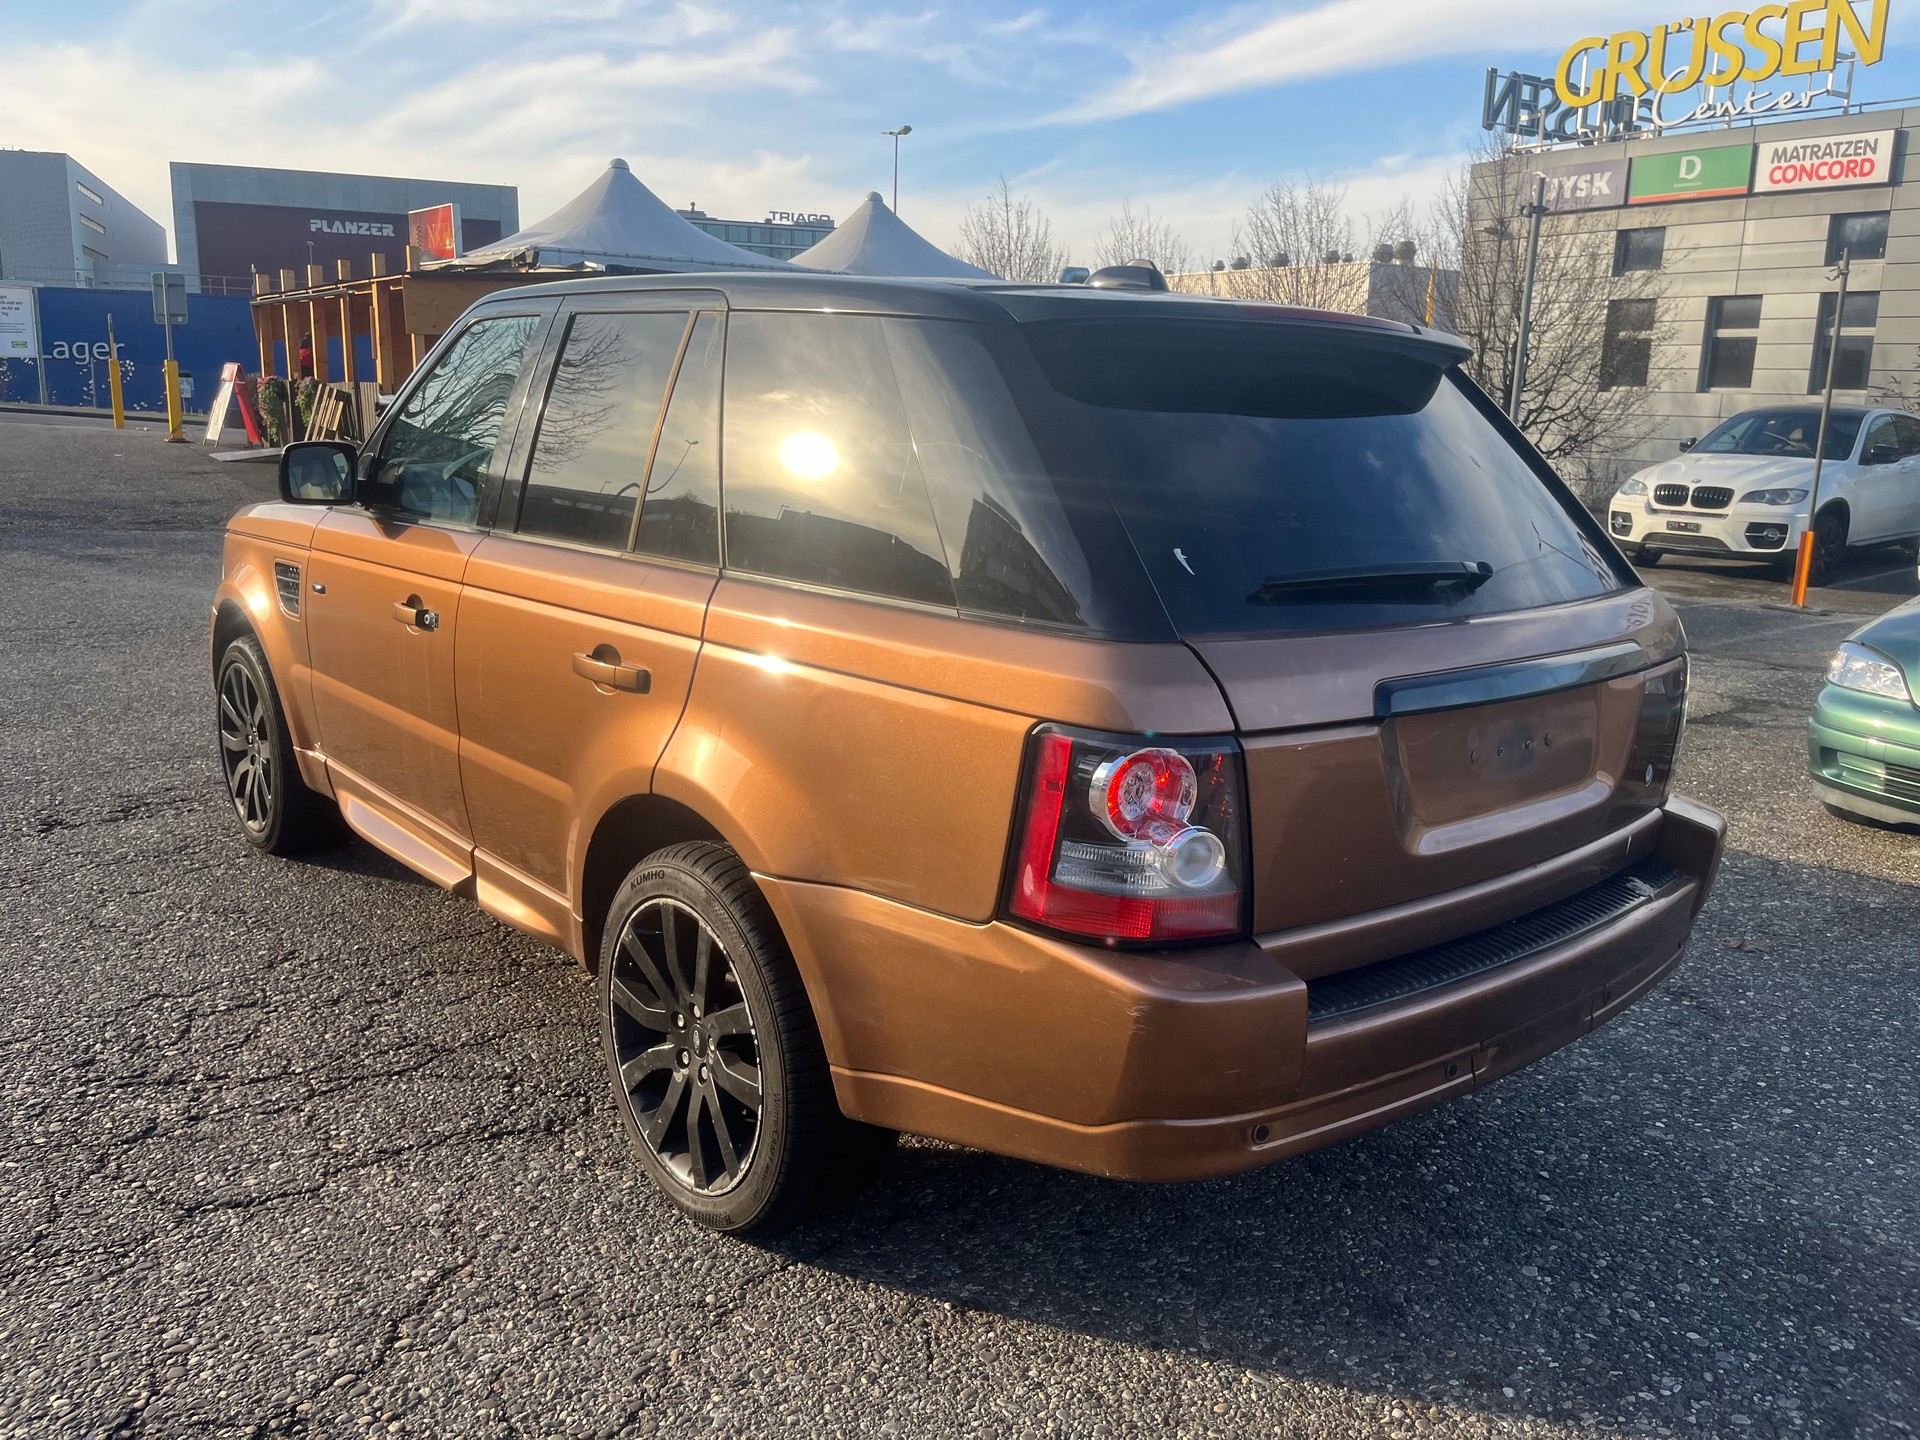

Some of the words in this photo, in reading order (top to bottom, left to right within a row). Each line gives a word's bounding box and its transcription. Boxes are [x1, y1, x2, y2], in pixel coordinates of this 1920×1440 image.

[1554, 0, 1890, 108] GRÜSSEN
[1652, 66, 1830, 127] Center
[1771, 138, 1878, 164] MATRATZEN
[1679, 155, 1702, 179] D
[1769, 158, 1875, 184] CONCORD
[310, 219, 395, 237] PLANZER
[630, 869, 665, 891] KUMHO
